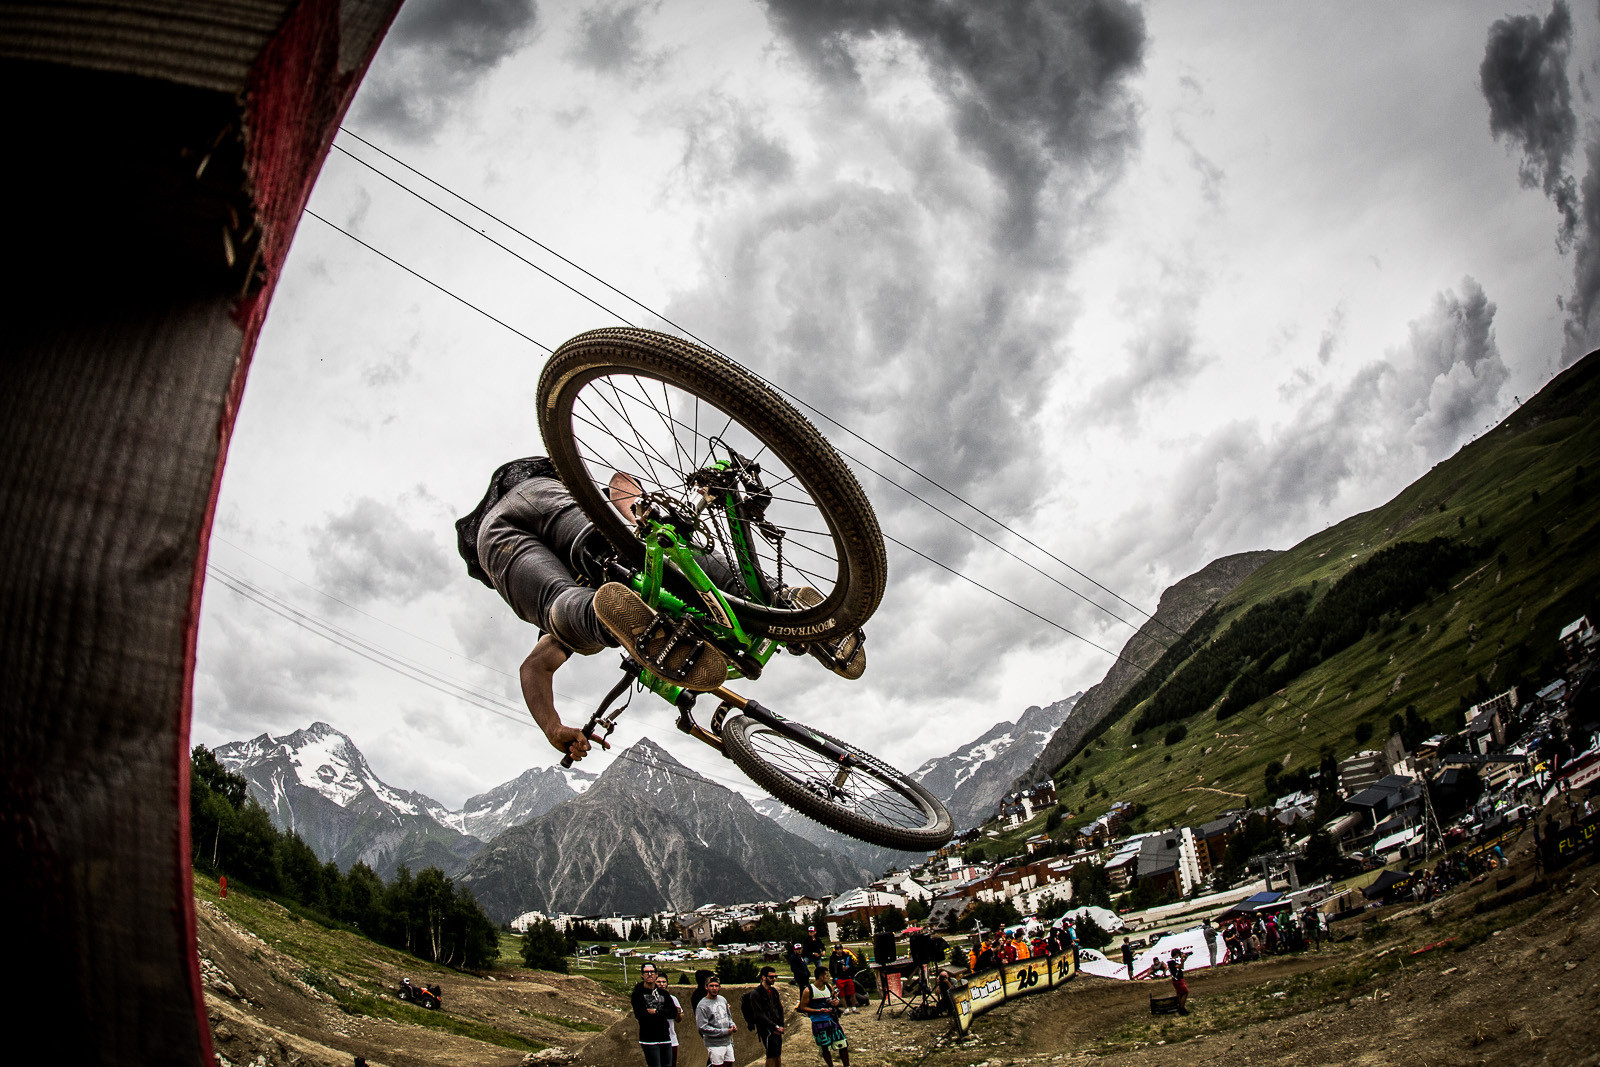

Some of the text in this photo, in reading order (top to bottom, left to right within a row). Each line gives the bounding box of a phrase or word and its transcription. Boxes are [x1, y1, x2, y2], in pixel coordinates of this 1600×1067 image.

[768, 620, 831, 636] BONTRAGER
[1017, 965, 1038, 991] 26
[1057, 956, 1069, 980] 26
